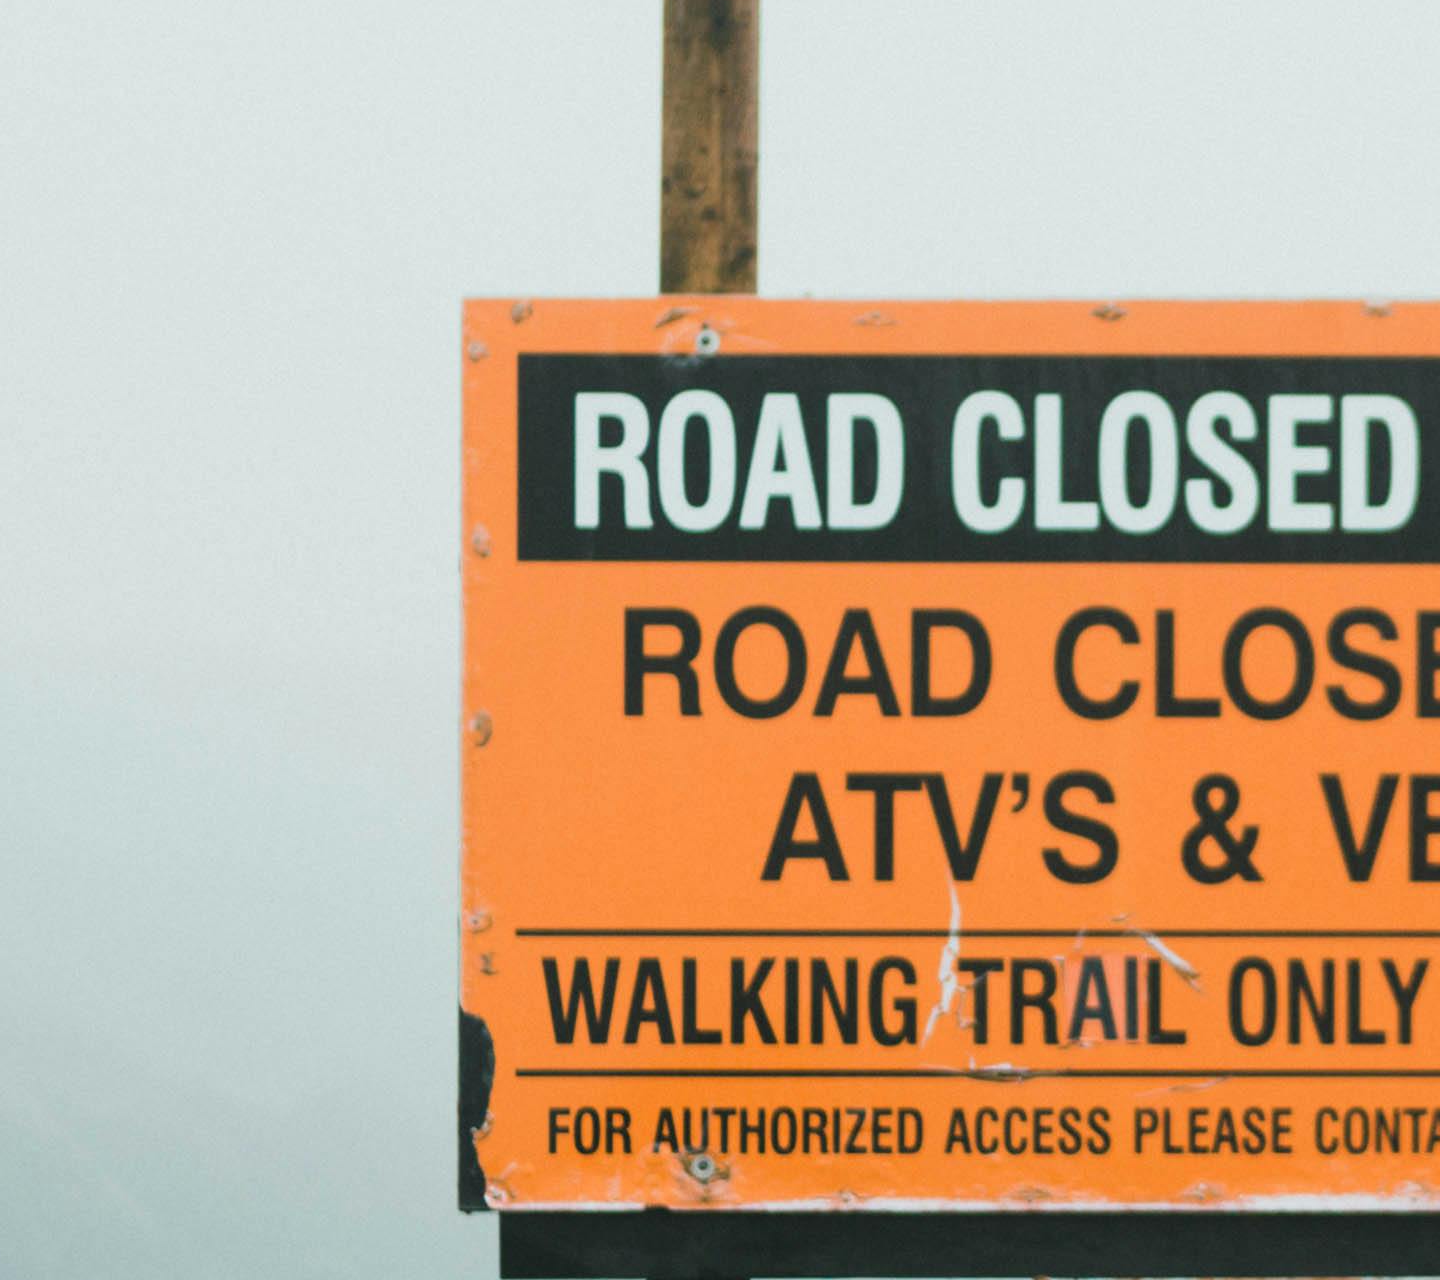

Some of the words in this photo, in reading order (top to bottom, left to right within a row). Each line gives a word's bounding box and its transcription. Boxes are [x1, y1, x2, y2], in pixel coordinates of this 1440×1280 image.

[574, 391, 904, 531] ROAD
[952, 390, 1418, 533] CLOSED
[623, 605, 993, 720] ROAD
[760, 770, 1120, 885] ATV'S
[1181, 773, 1264, 886] &
[542, 956, 918, 1047] WALKING
[958, 956, 1187, 1046] TRAIL
[1228, 956, 1429, 1047] ONLY
[548, 1106, 632, 1156] FOR
[653, 1106, 924, 1156] AUTHORIZED
[944, 1107, 1111, 1156] ACCESS
[1134, 1107, 1293, 1155] PLEASE
